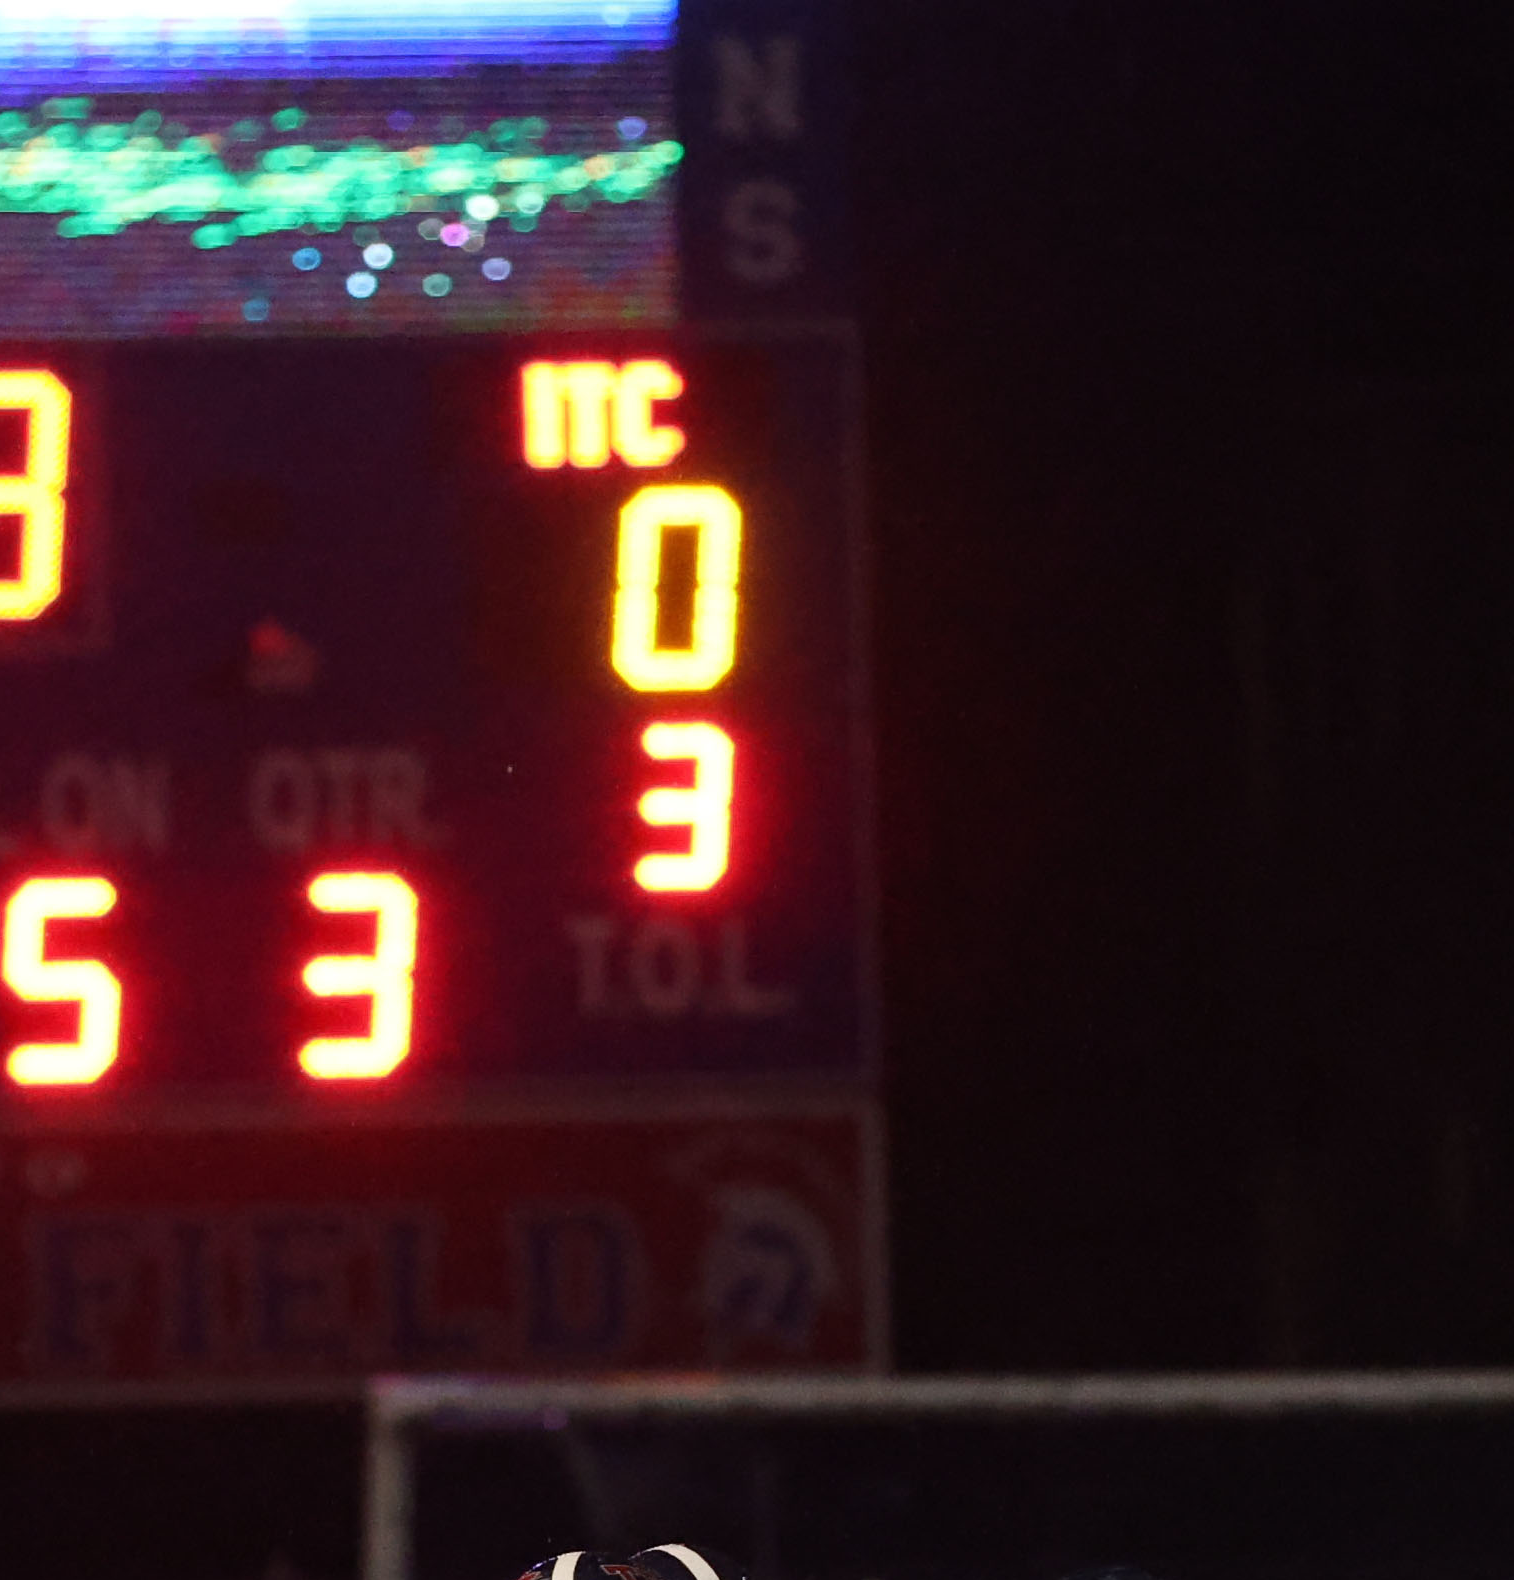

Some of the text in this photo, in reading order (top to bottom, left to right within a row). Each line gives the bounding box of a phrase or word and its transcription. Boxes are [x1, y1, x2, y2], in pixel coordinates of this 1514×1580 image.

[609, 484, 745, 695] 0
[41, 748, 173, 856] ON
[633, 720, 736, 893] 3
[0, 876, 123, 1086] 5
[298, 871, 419, 1080] 3
[23, 1203, 657, 1382] FIELD
